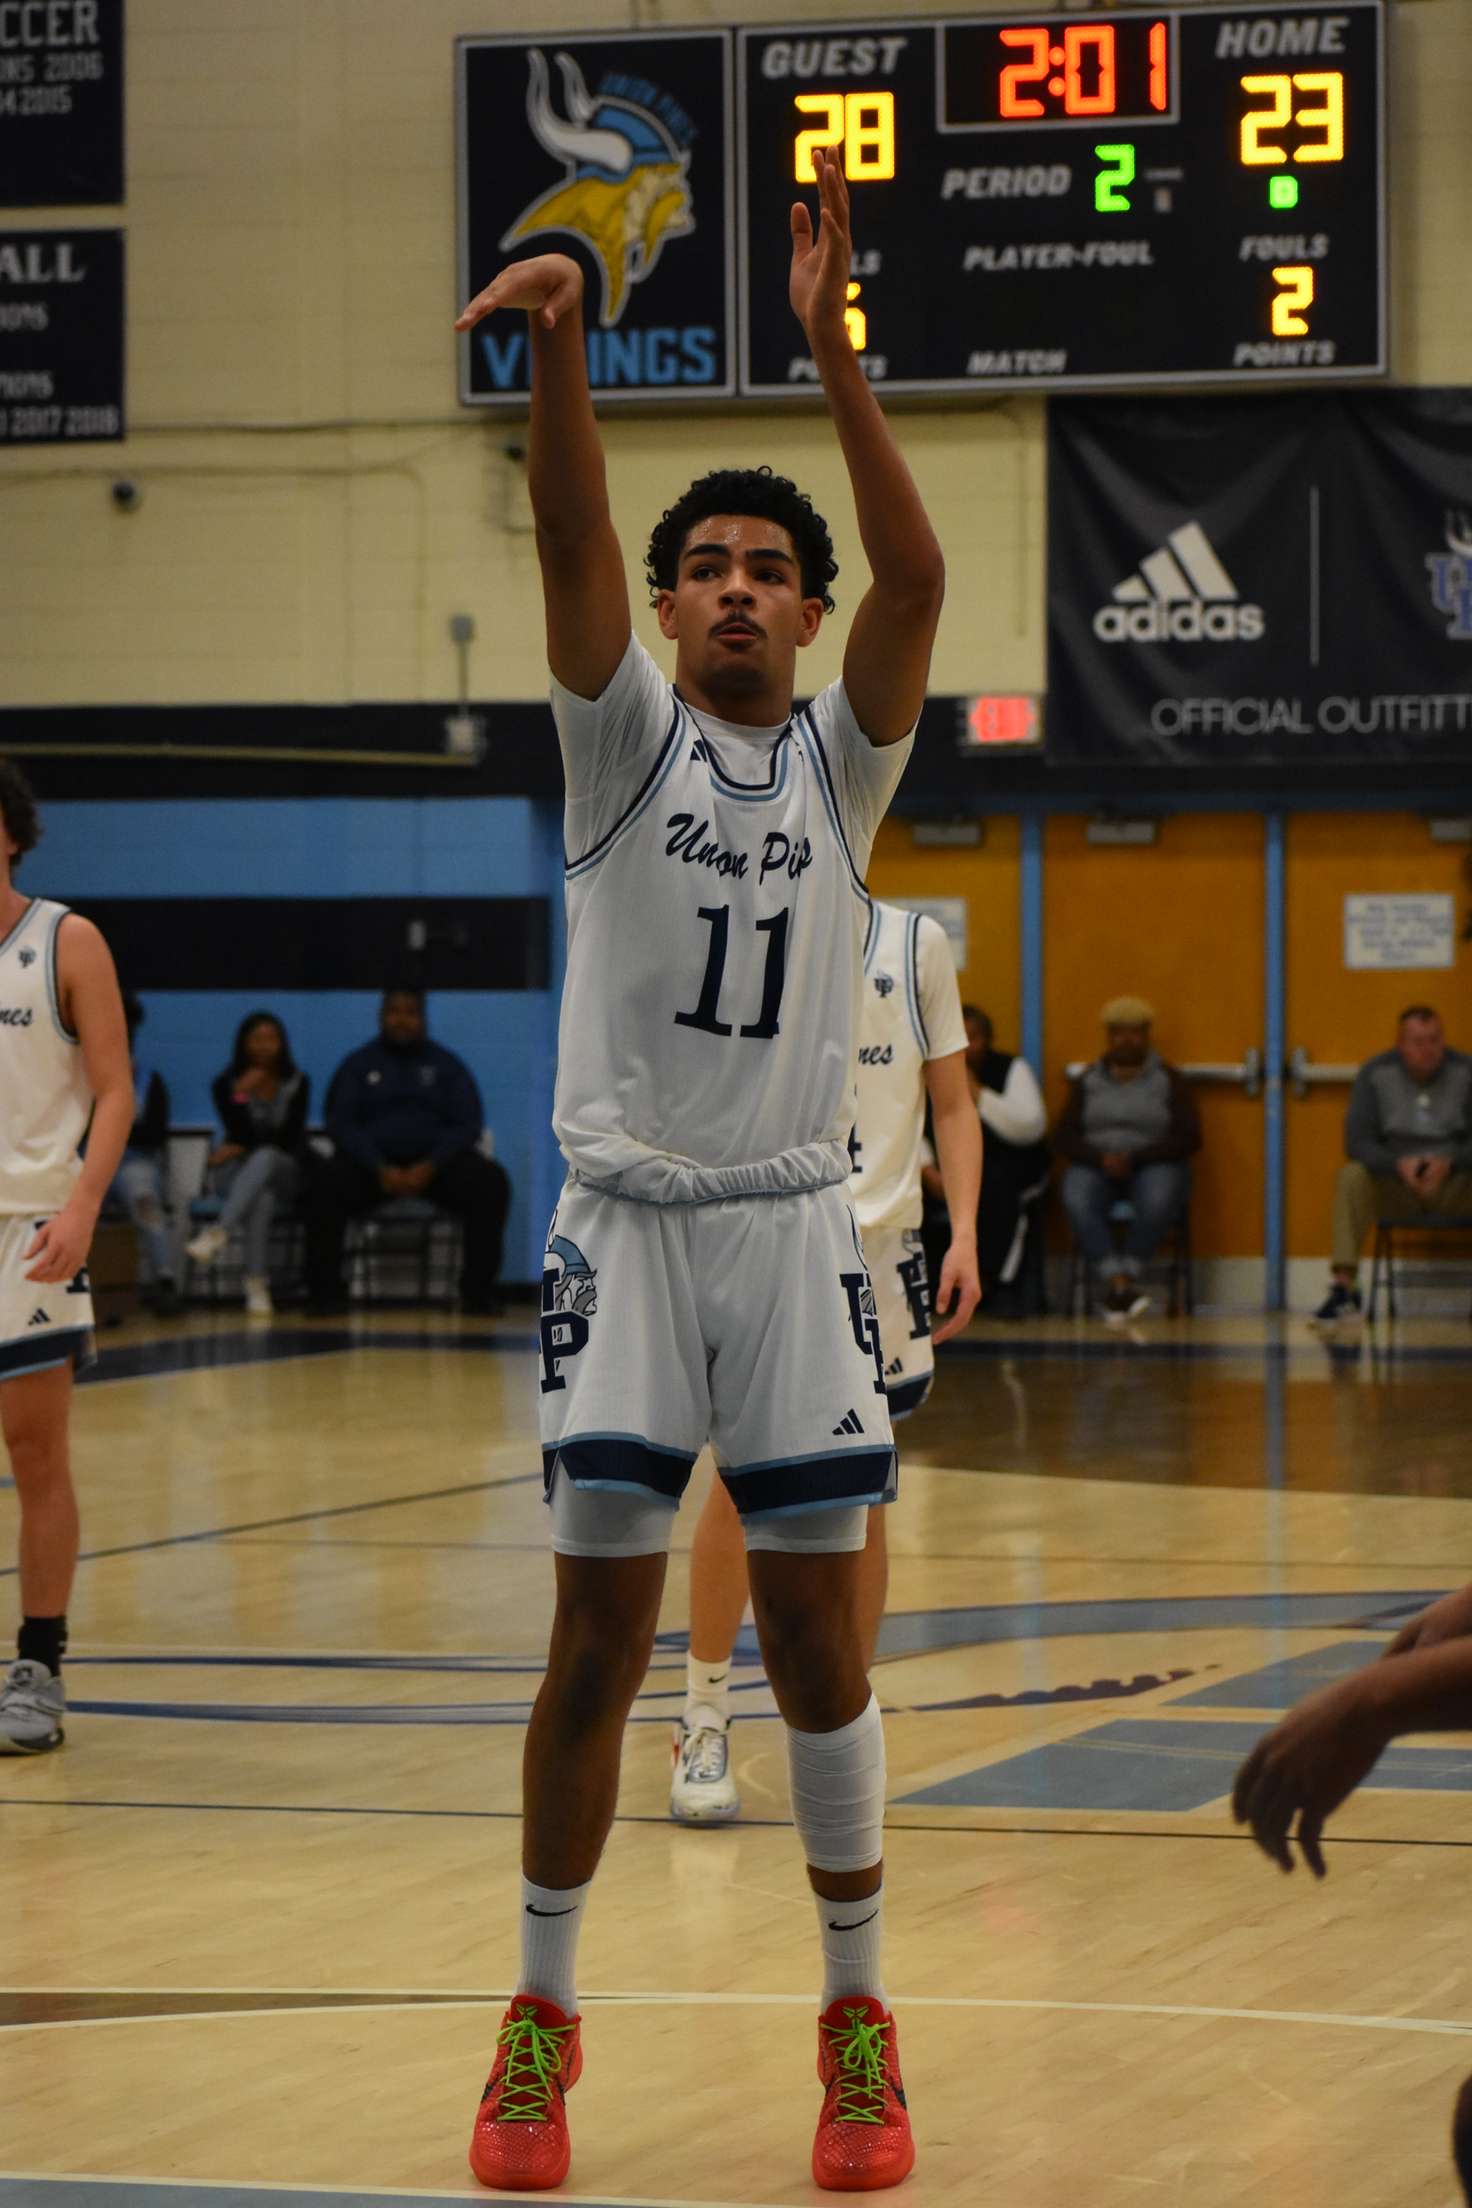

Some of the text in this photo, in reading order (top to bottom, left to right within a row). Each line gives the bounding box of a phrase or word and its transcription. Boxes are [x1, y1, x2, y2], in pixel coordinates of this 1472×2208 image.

[761, 37, 907, 79] GUEST
[1215, 17, 1350, 58] HOME
[999, 22, 1167, 118] 2:01
[793, 91, 896, 184] 28
[1239, 71, 1345, 166] 23
[941, 164, 1072, 200] PERIOD
[1093, 143, 1136, 213] 2
[962, 242, 1154, 271] PLAYER-FOUL
[1238, 234, 1329, 261] FOULS
[1271, 266, 1314, 336] 2
[481, 326, 717, 388] VINGS
[966, 350, 1067, 375] MATCH
[1233, 341, 1336, 367] POINTS
[1094, 603, 1265, 643] adidas
[1150, 696, 1314, 737] OFFICIAL
[673, 904, 789, 1040] 11
